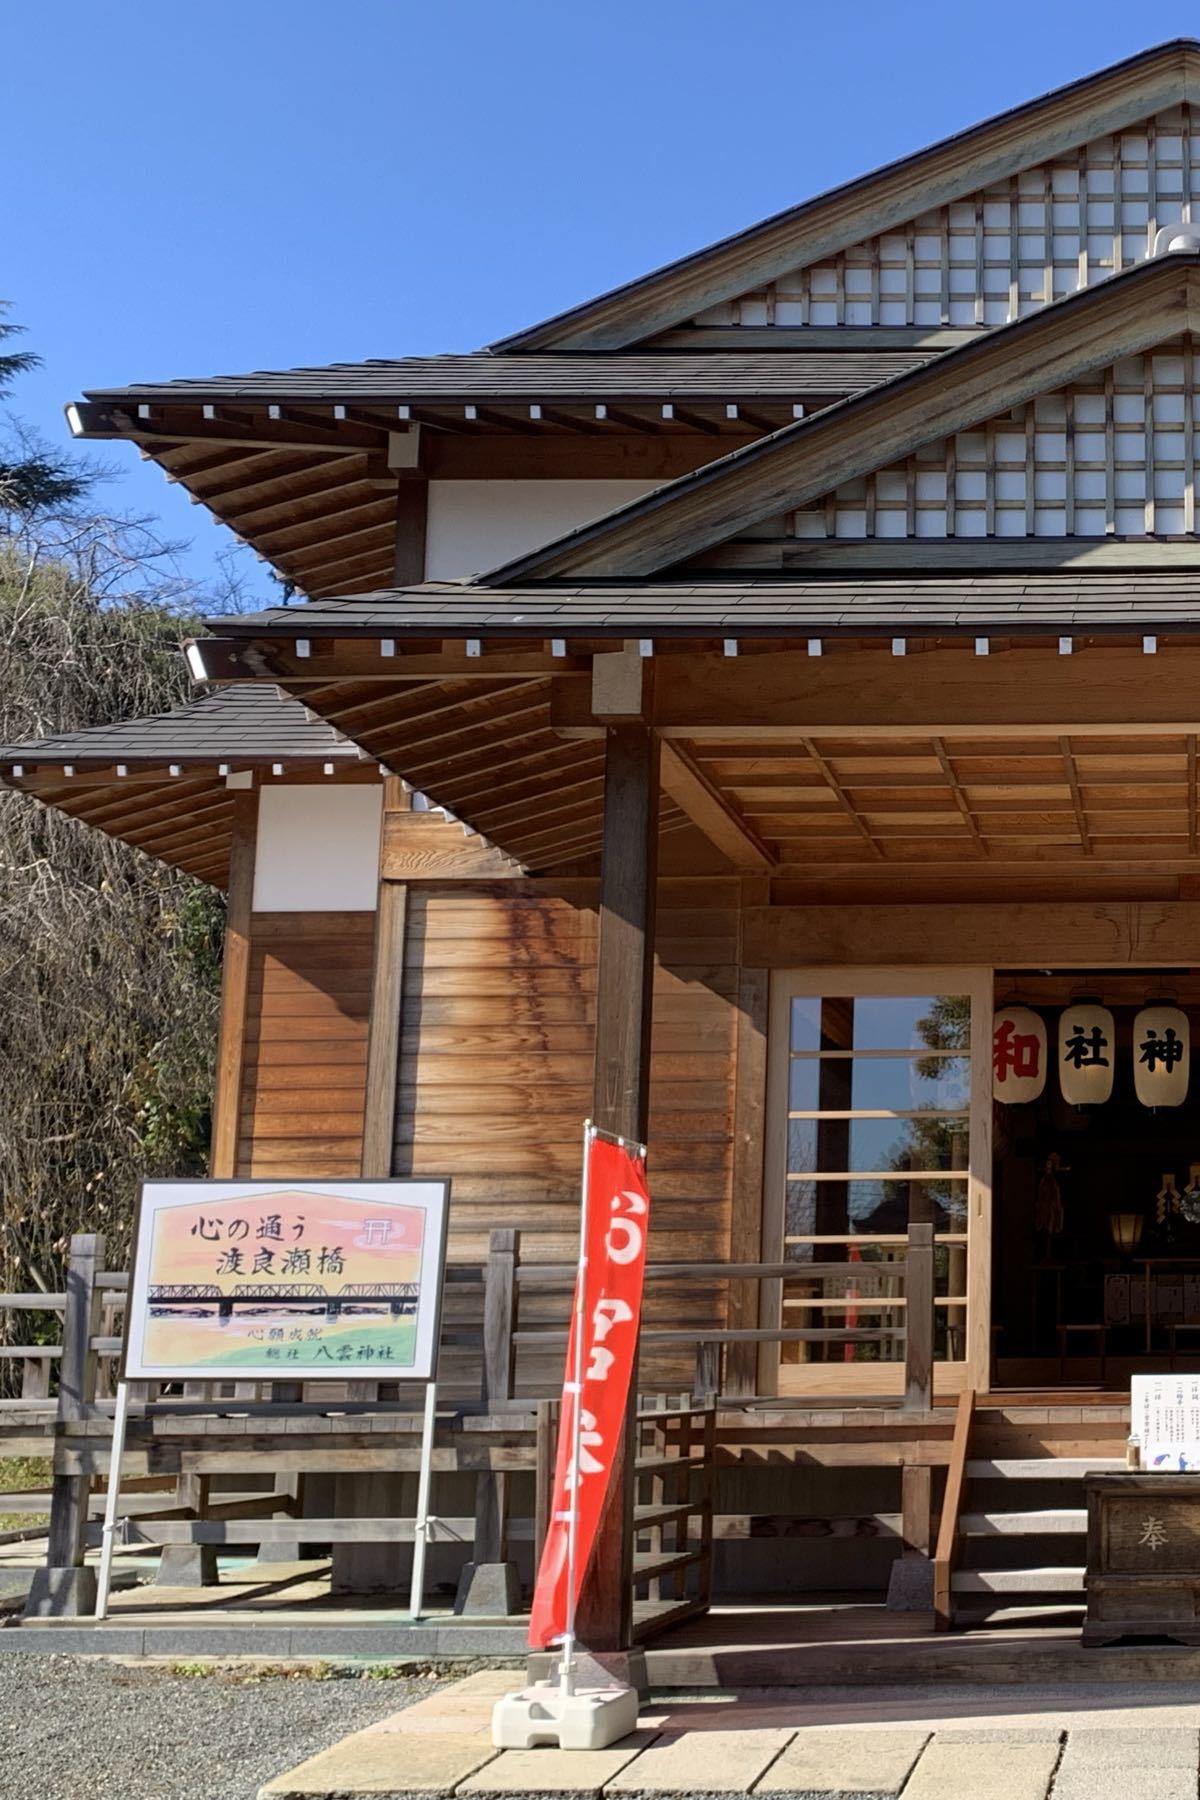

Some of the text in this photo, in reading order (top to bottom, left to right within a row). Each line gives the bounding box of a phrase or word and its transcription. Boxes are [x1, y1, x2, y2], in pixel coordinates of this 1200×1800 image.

[191, 1215, 306, 1242] 心の通う
[216, 1246, 347, 1276] 渡良瀬橋
[313, 1344, 395, 1361] 八雲神社
